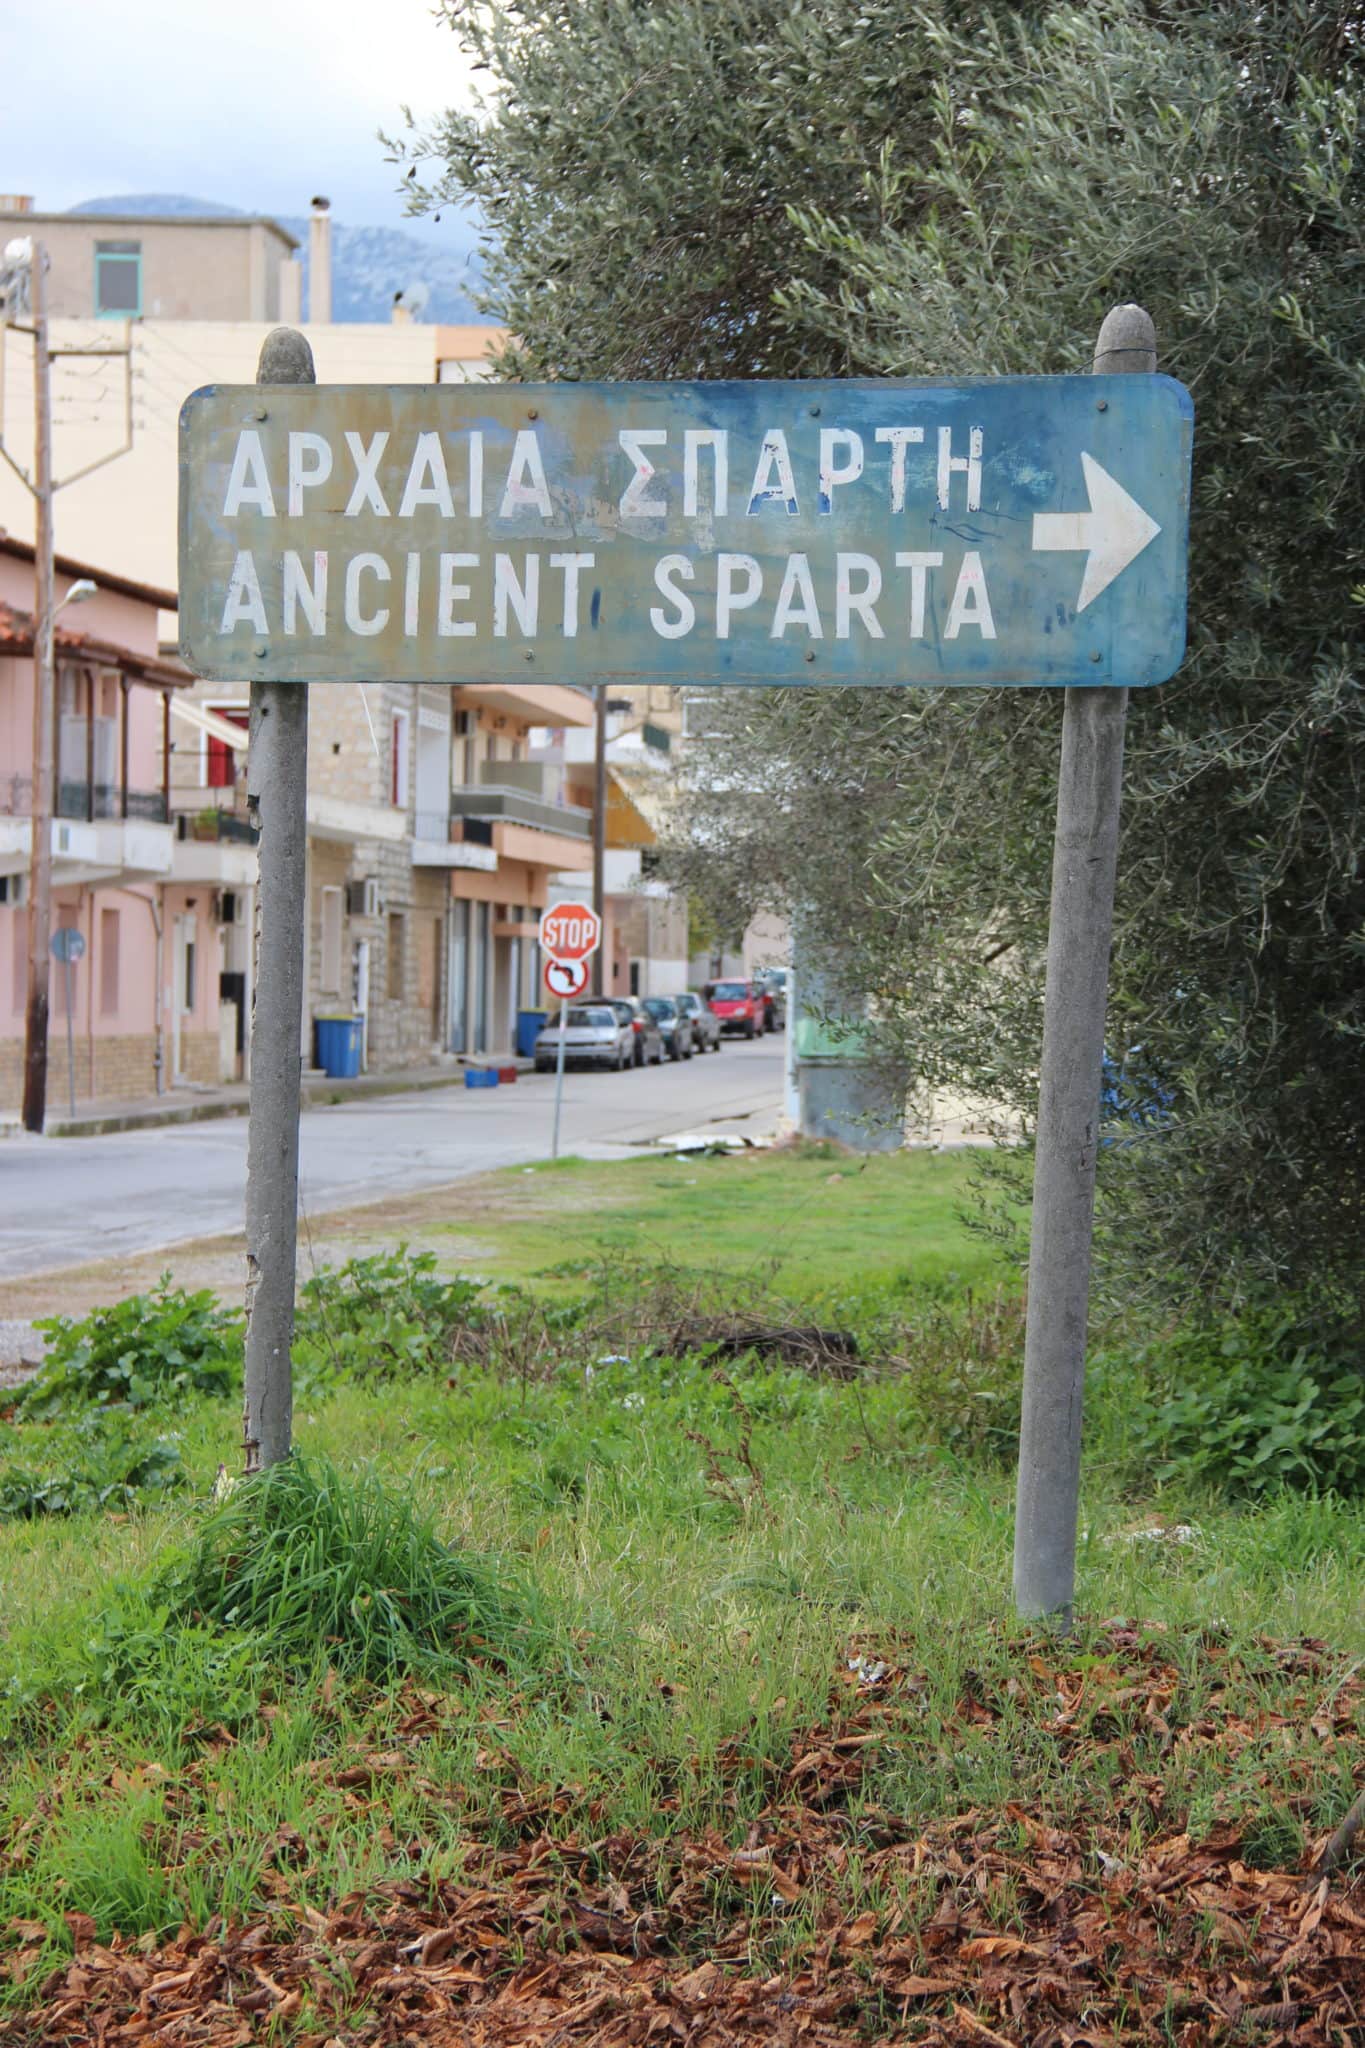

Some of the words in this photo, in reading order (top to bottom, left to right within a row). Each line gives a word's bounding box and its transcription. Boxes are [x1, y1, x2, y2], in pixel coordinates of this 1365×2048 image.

[222, 429, 554, 518] ΑΡΧΑΙΑ
[618, 425, 984, 518] ΣΠΑΡΤΗ
[219, 550, 596, 639] ANCIENT
[649, 550, 998, 640] SPARTA
[544, 917, 595, 949] STOP
